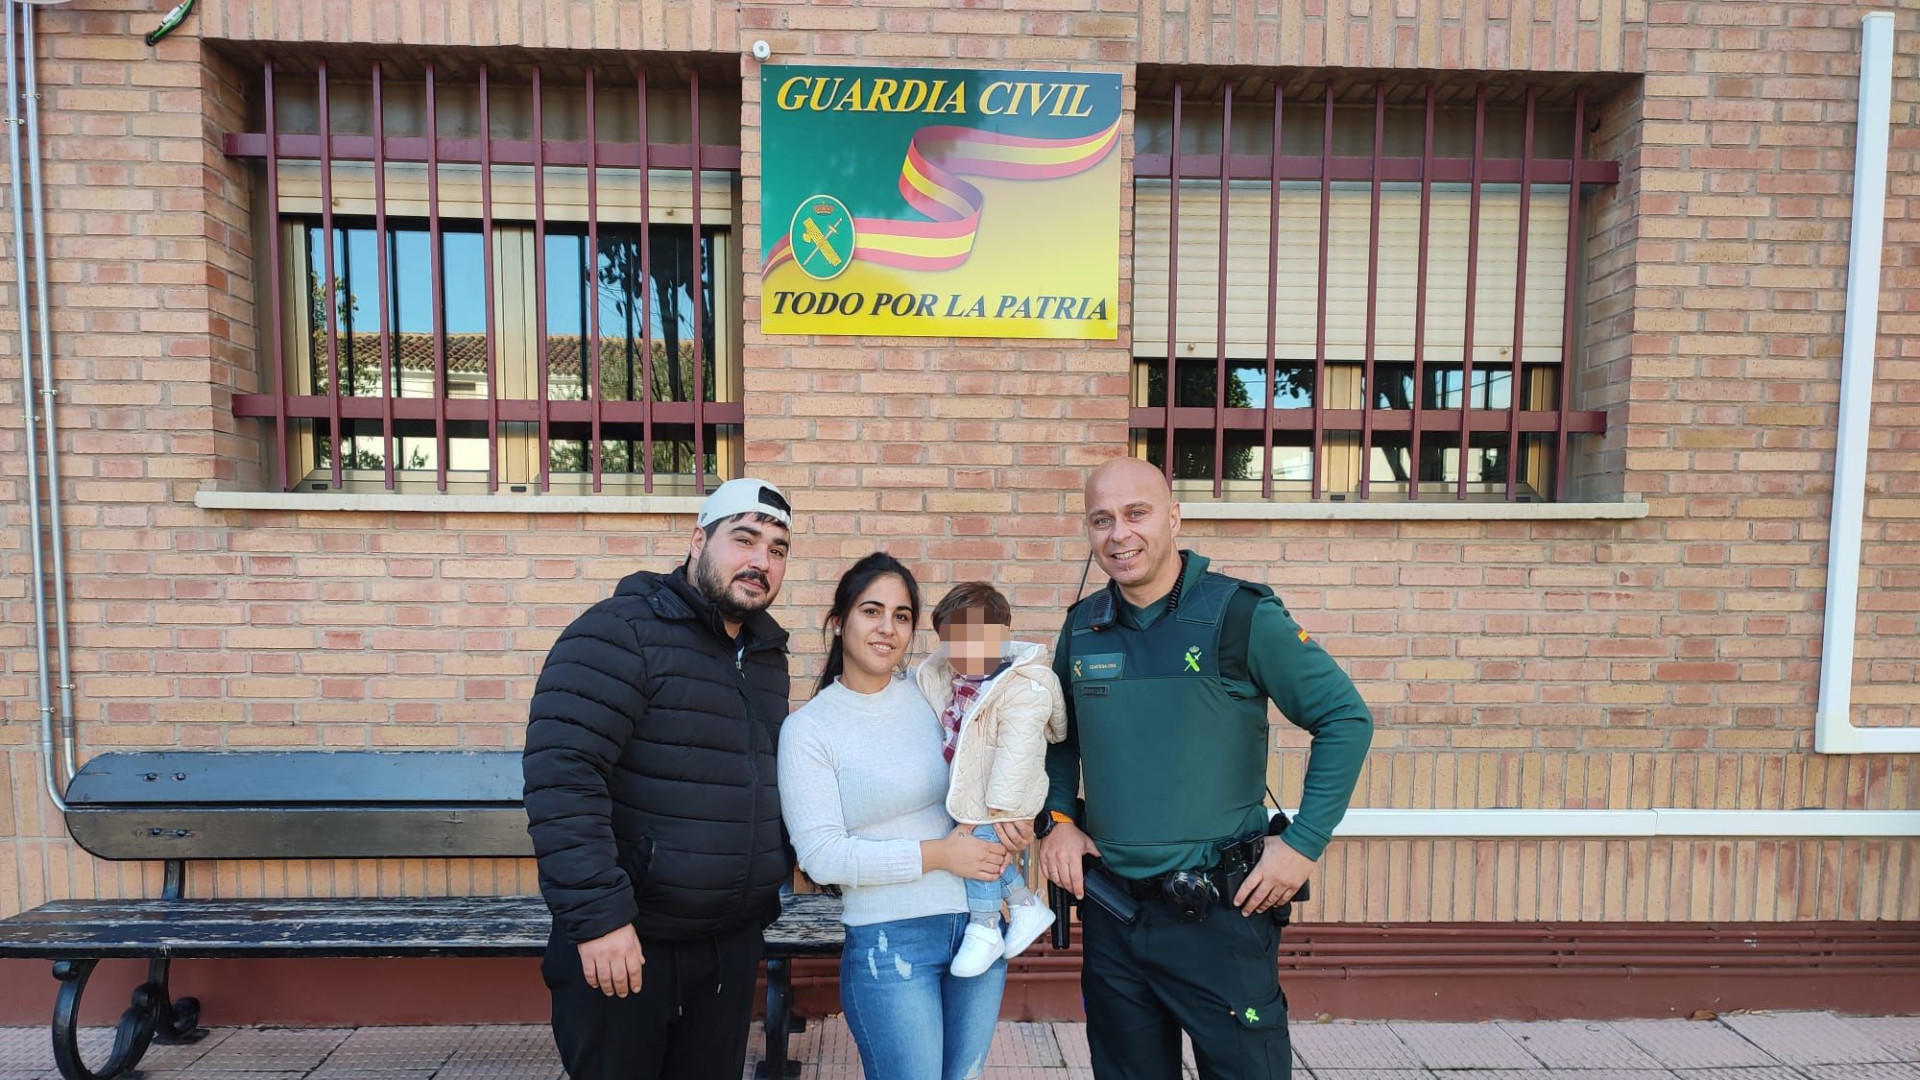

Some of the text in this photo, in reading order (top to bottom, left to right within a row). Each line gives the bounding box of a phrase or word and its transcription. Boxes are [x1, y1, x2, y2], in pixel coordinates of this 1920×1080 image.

[777, 77, 1093, 117] GUARDIA CIVIL
[772, 291, 1107, 320] TODO POR LA PATRIA
